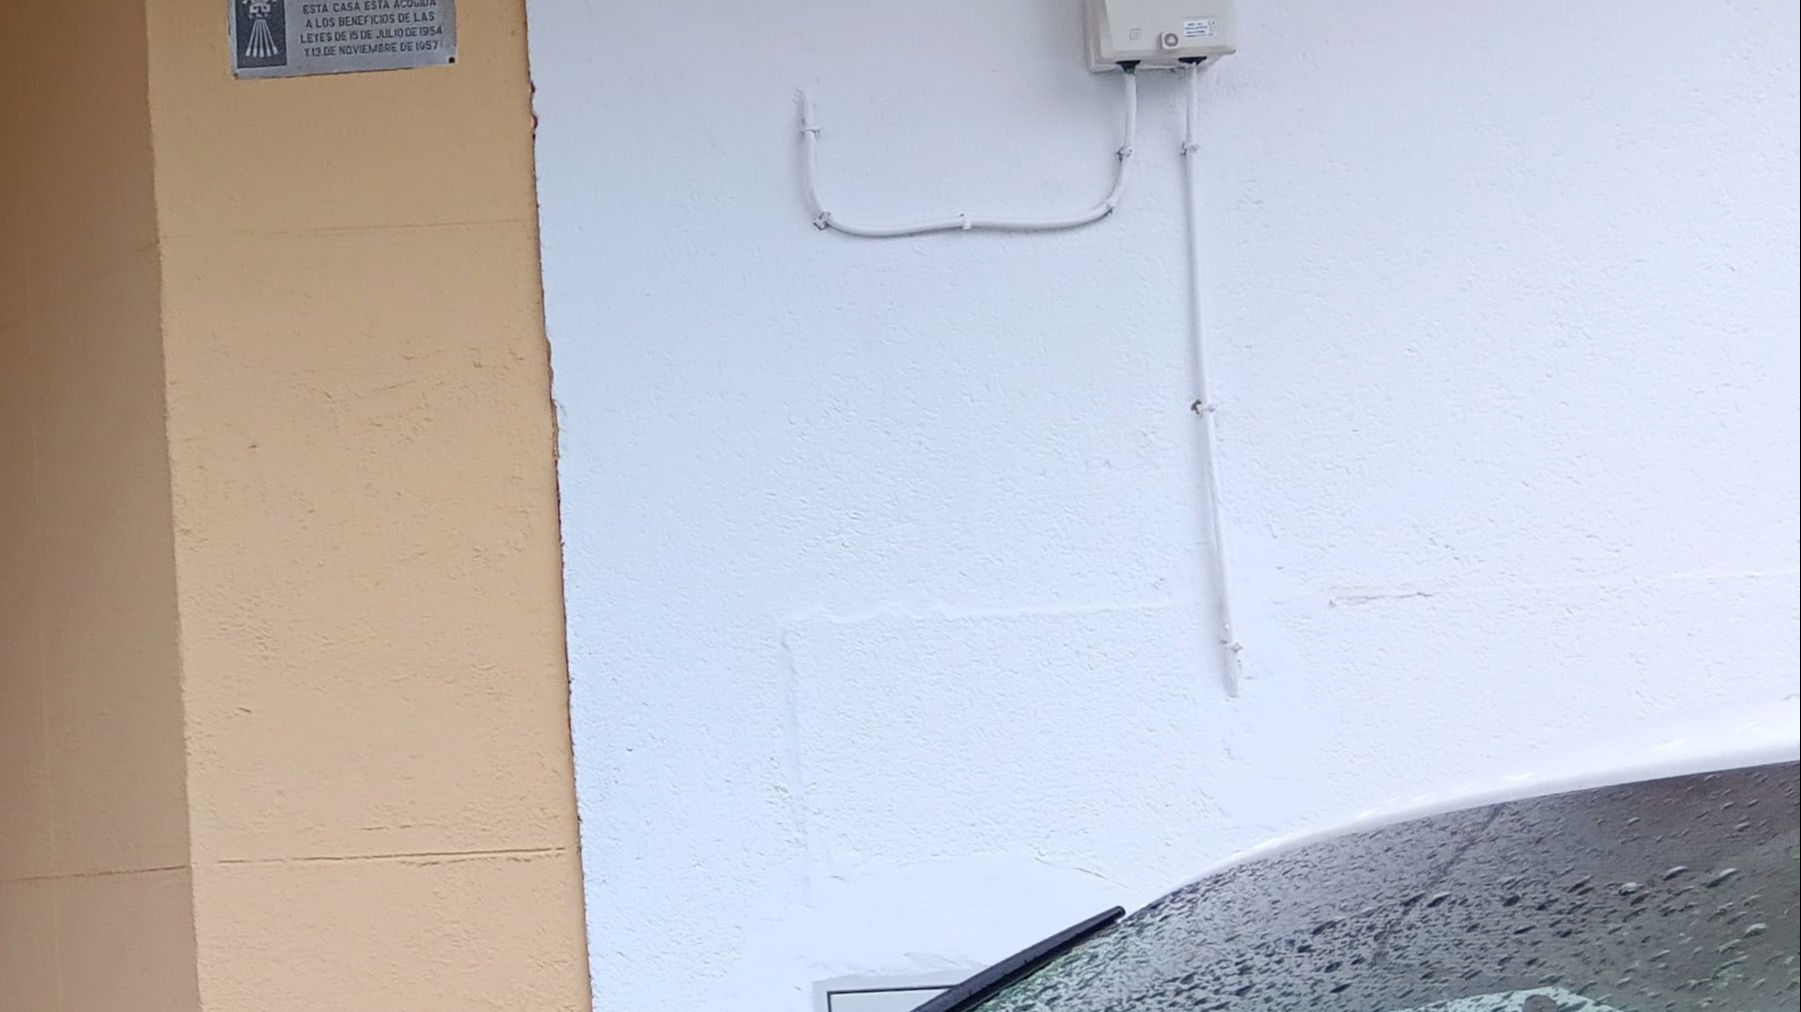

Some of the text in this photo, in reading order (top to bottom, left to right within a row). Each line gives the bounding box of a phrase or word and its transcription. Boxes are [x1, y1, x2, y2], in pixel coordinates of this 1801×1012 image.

[302, 3, 329, 15] ESTA
[332, 1, 361, 13] CASA
[364, 0, 390, 11] ESTA
[305, 11, 436, 29] A LOS BENEFICIOS DE LAS
[300, 25, 443, 44] LEYES DE 15 DE JULIO DE 1954
[323, 45, 337, 56] DE
[338, 42, 398, 56] NOVIEMBRE
[399, 41, 414, 52] DE
